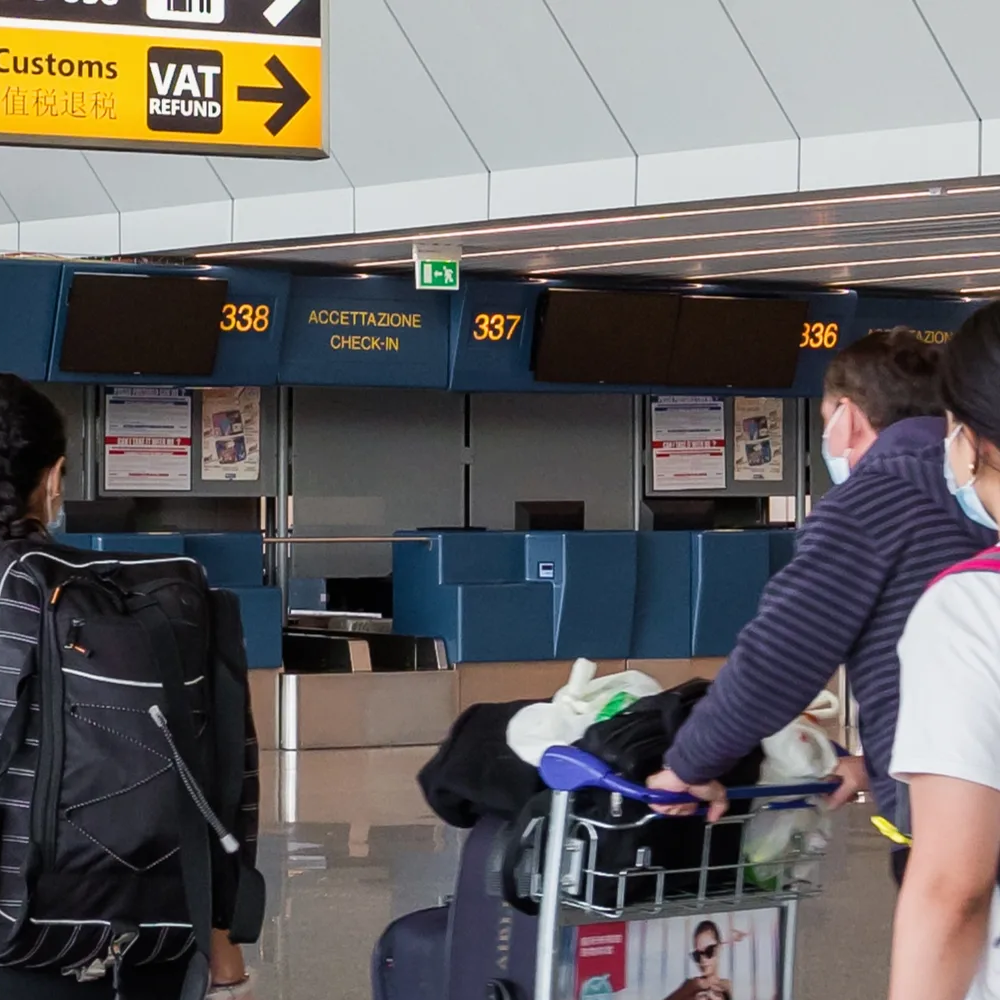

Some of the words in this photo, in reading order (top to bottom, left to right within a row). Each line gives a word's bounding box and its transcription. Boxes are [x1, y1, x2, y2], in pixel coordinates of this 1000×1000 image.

[149, 62, 221, 98] VAT
[149, 98, 221, 118] REFUND
[219, 303, 270, 332] 338
[308, 310, 422, 328] ACCETTAZIONE
[473, 313, 521, 340] 337
[330, 335, 399, 351] CHECK-IN
